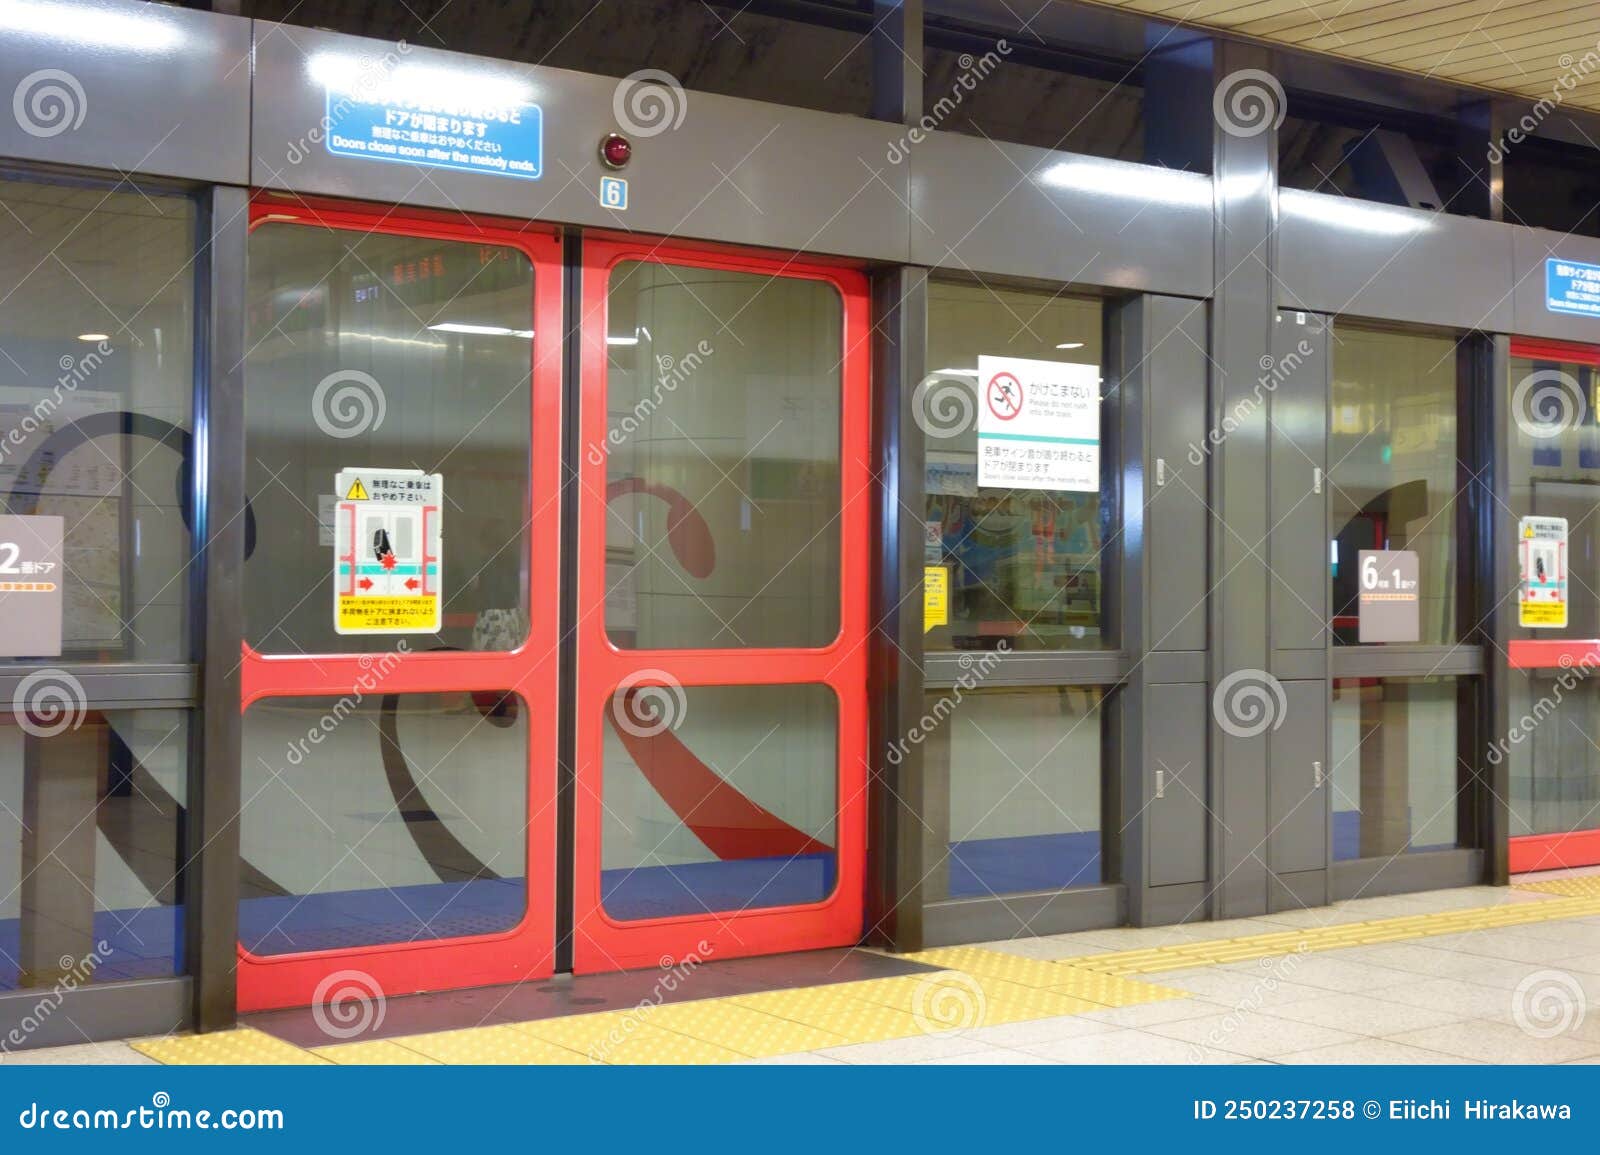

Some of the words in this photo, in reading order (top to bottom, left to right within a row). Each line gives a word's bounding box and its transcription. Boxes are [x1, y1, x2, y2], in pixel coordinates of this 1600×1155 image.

[333, 135, 366, 151] Doors
[368, 140, 396, 154] close
[399, 146, 425, 158] soon
[427, 148, 451, 161] after
[452, 150, 469, 163] the
[471, 154, 507, 170] melody
[509, 159, 537, 172] ends.
[607, 181, 621, 205] 6
[1029, 383, 1091, 399] かけこまない
